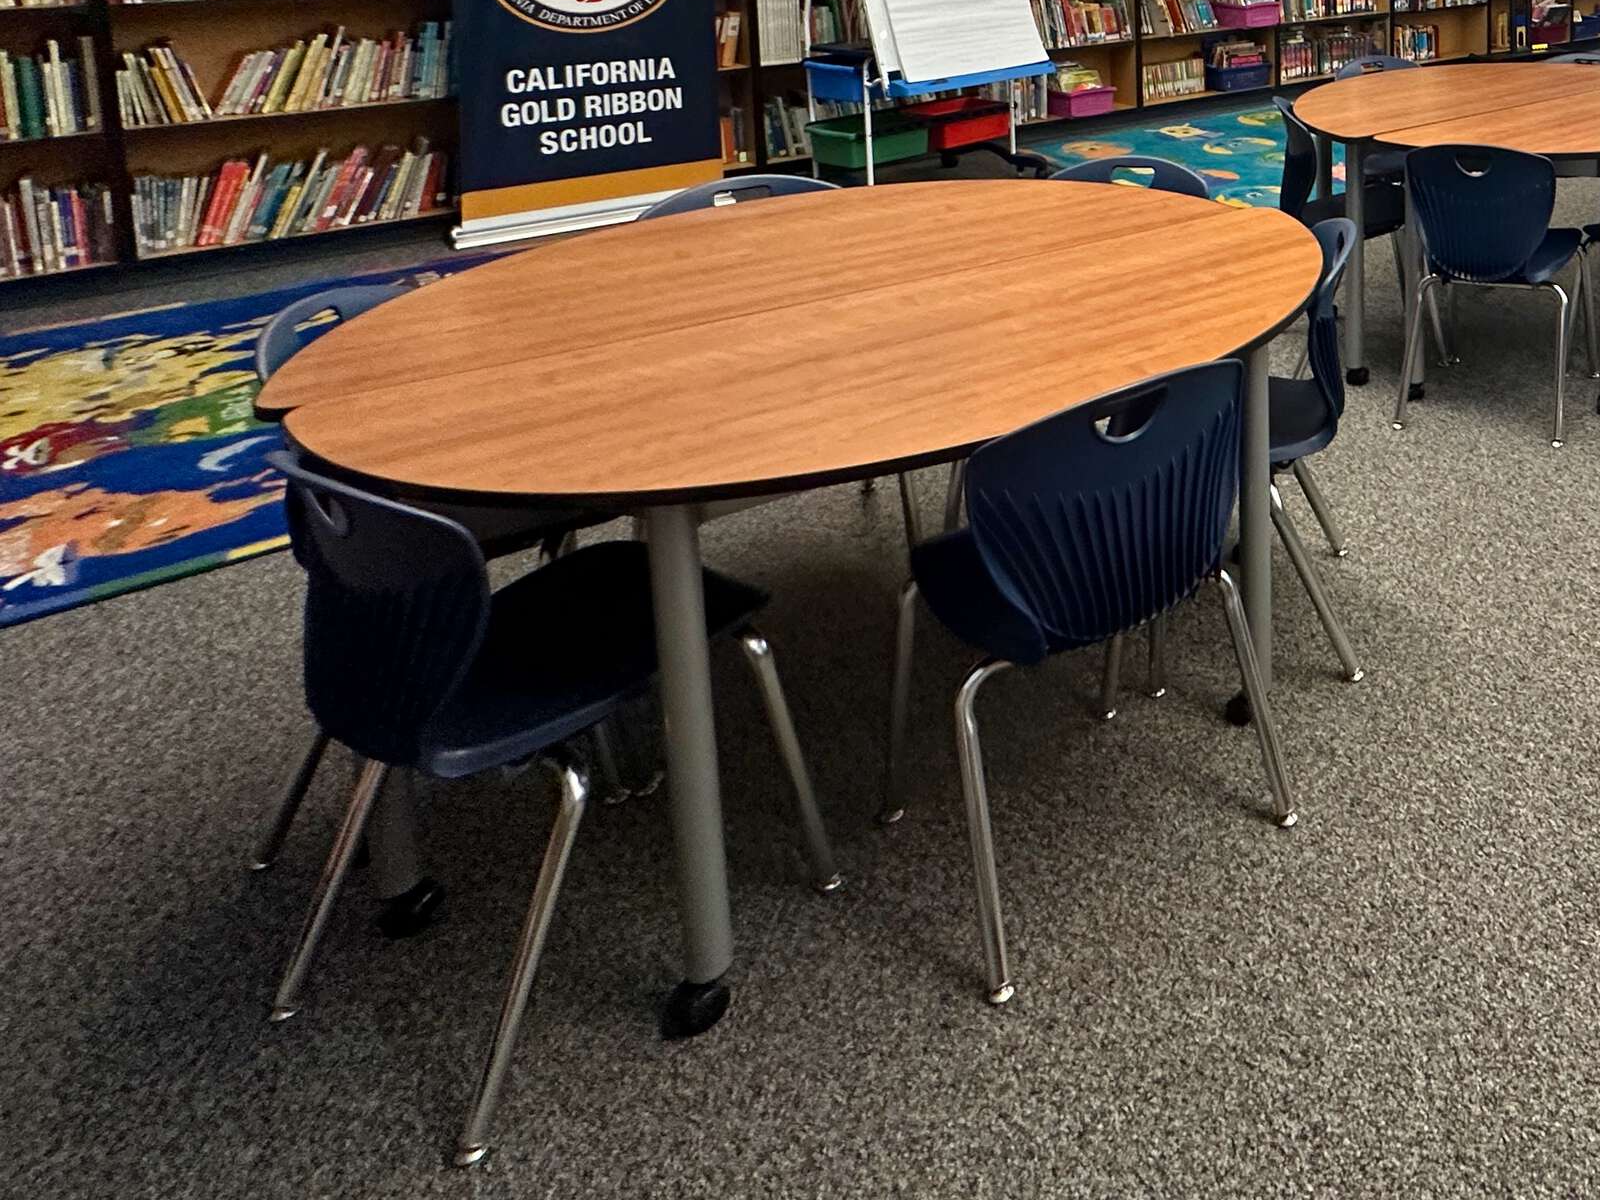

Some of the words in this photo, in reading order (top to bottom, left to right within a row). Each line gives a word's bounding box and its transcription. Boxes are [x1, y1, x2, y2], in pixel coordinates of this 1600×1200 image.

[538, 8, 629, 27] DEPARTMENT
[629, 1, 645, 15] OF
[506, 57, 676, 94] CALIFORNIA
[501, 97, 576, 128] GOLD
[584, 87, 683, 119] RIBBON
[540, 121, 652, 155] SCHOOL
